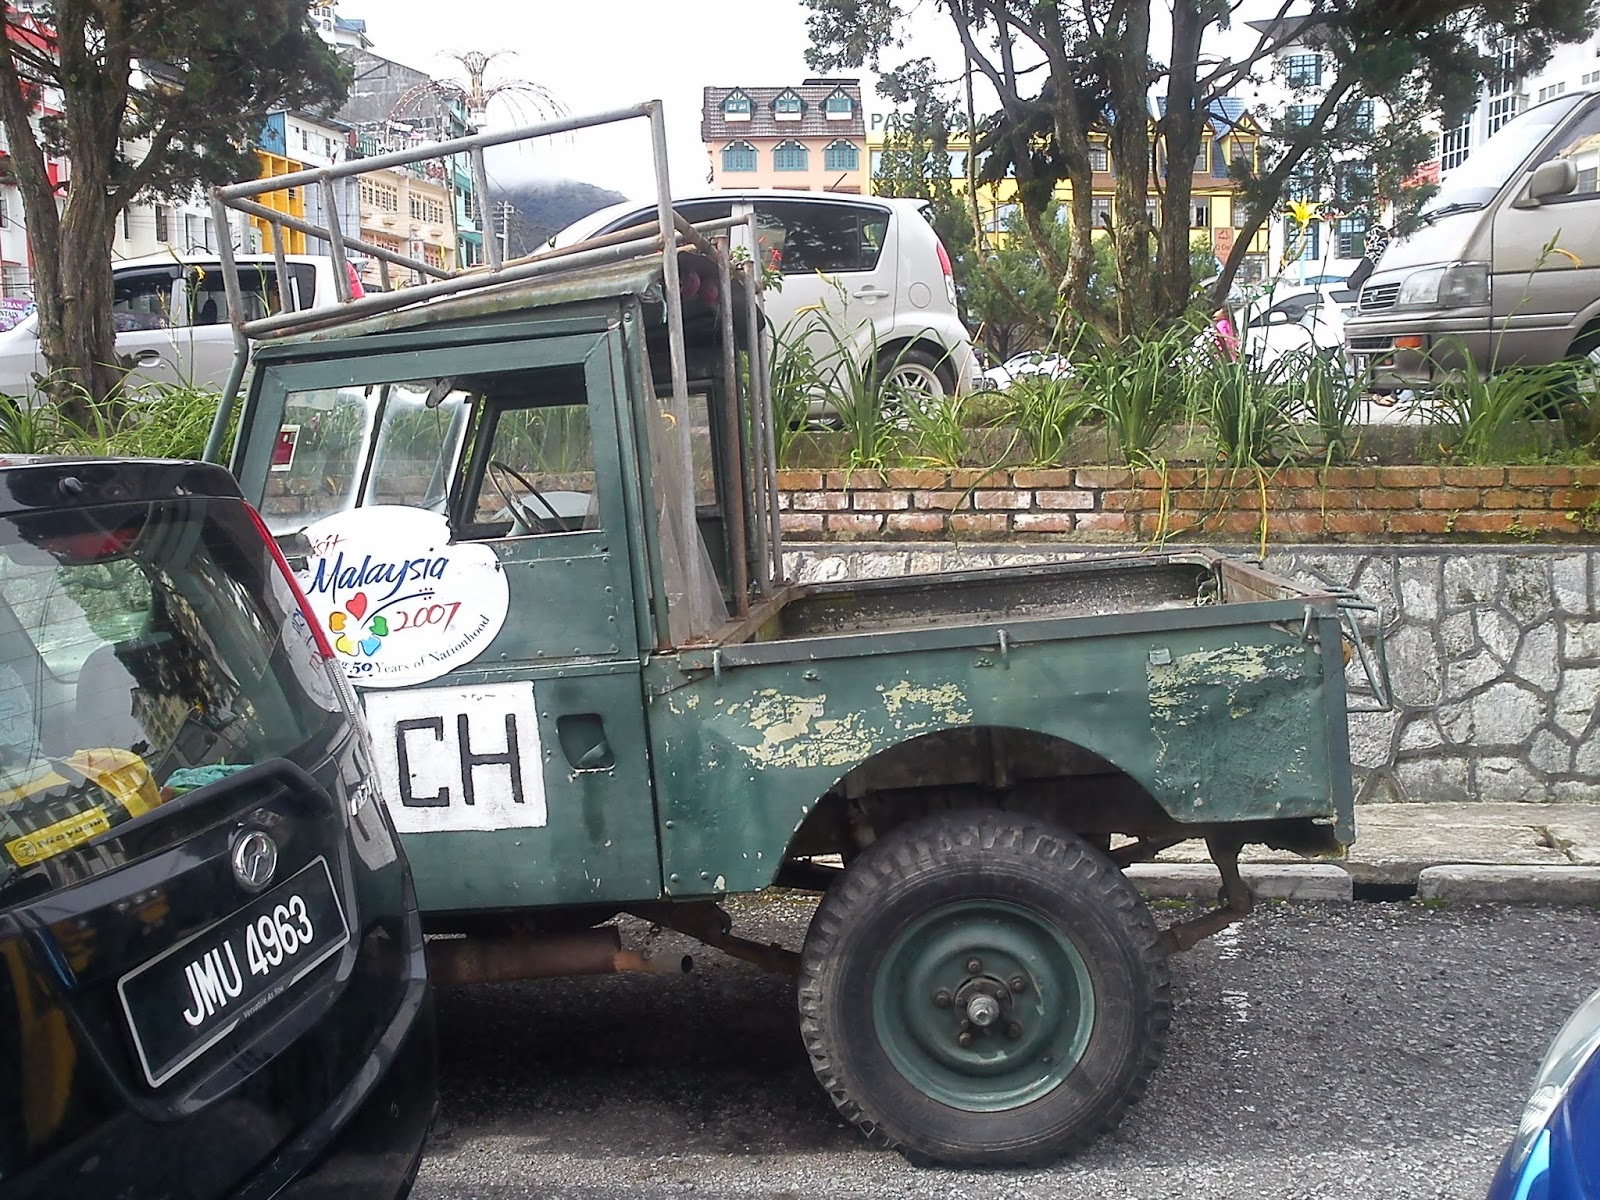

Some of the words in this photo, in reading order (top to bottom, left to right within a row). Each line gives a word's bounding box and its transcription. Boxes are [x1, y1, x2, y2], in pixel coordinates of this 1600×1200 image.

[305, 547, 449, 604] Malaysia
[351, 662, 373, 674] 50
[375, 662, 410, 674] Years
[414, 655, 426, 668] of
[428, 614, 490, 663] Nationhood
[393, 602, 462, 633] 2007
[395, 713, 525, 807] CH
[183, 940, 243, 1026] JMU
[246, 895, 314, 976] 4963
